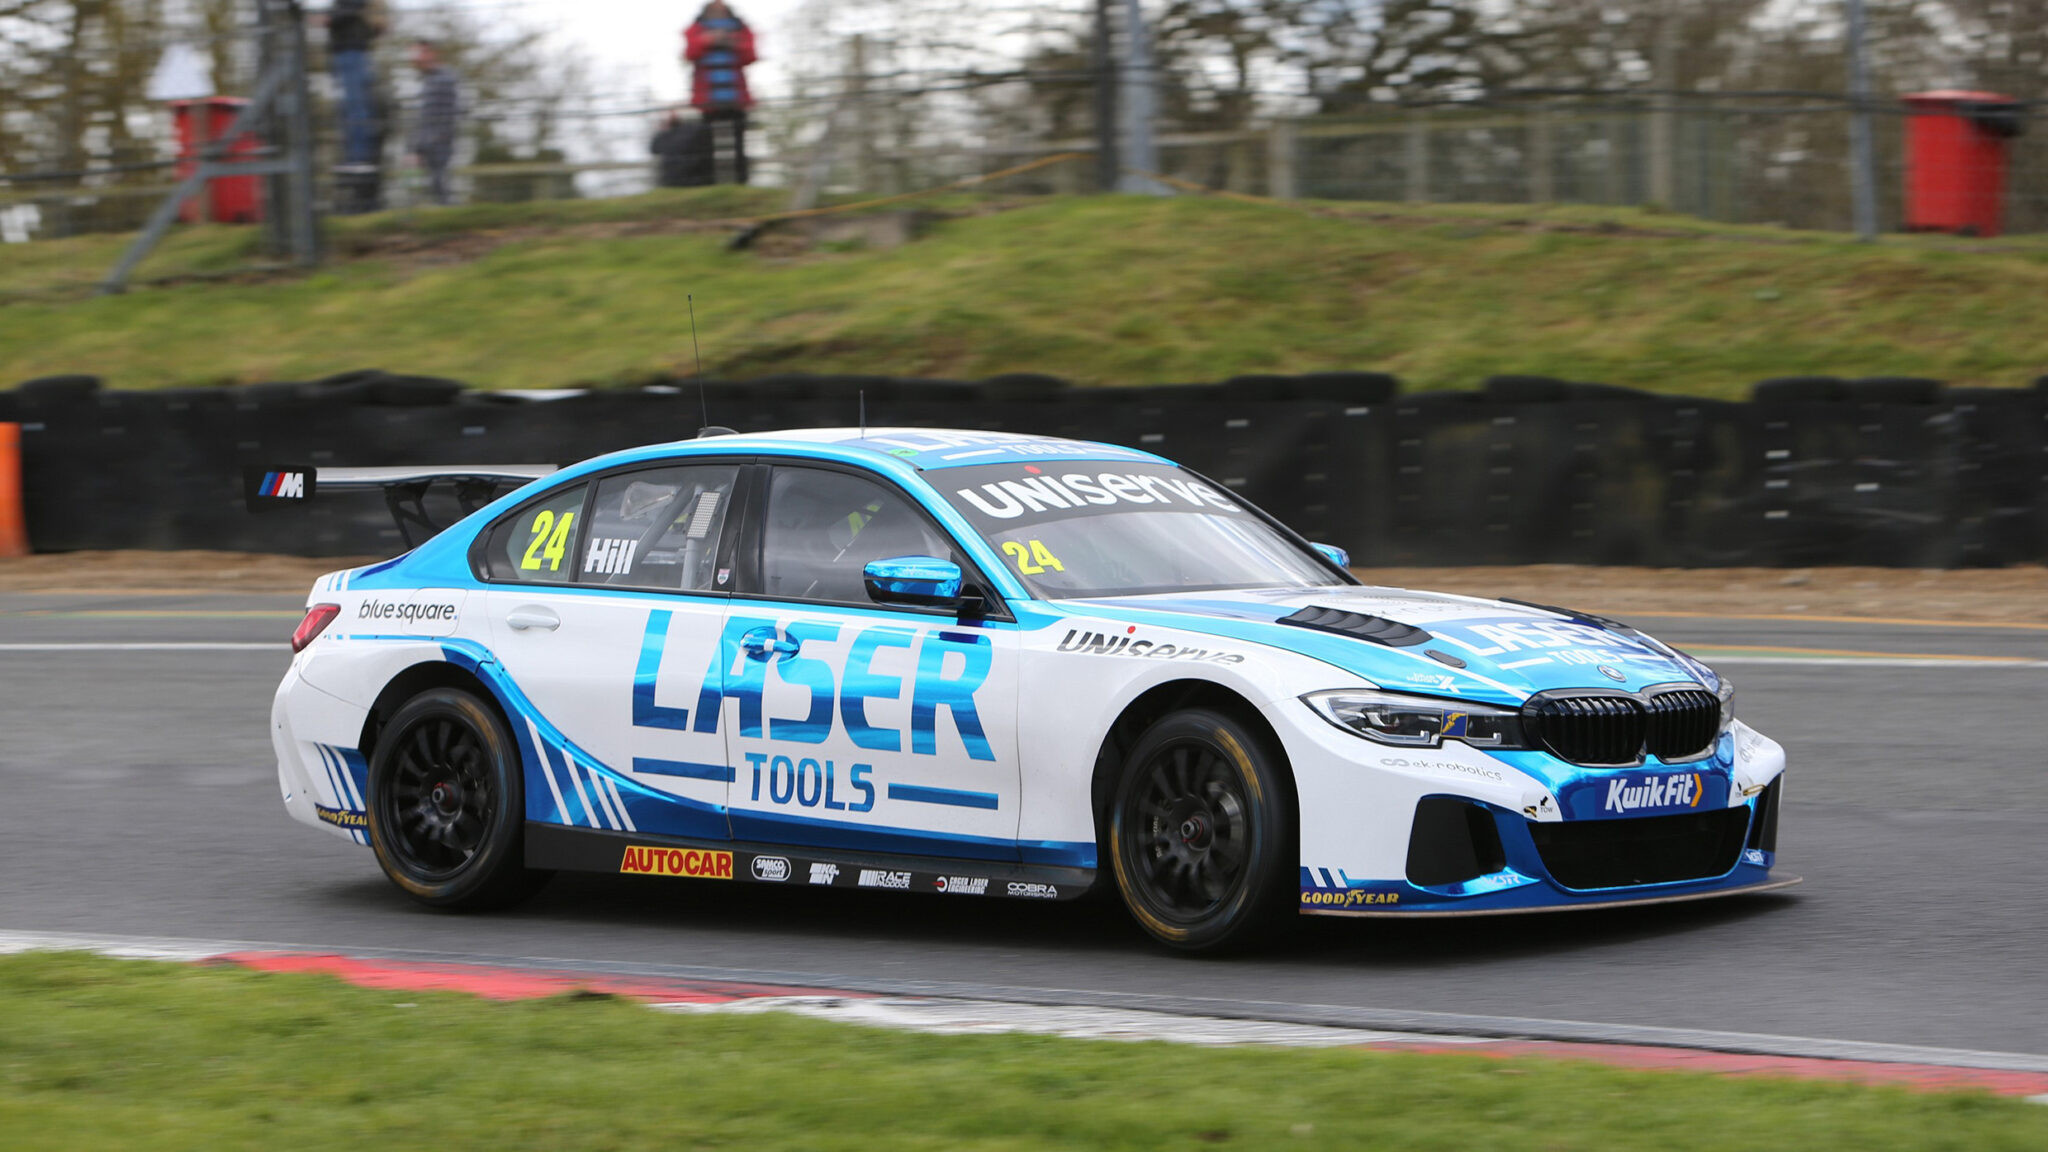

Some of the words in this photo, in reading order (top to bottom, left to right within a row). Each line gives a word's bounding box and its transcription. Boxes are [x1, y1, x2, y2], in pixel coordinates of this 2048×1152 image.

[520, 510, 575, 572] 24
[584, 538, 638, 575] Hill
[1002, 540, 1065, 575] 24
[359, 598, 394, 620] blue
[1465, 621, 1645, 657] LASER
[1547, 649, 1625, 666] TOOLS
[632, 609, 996, 762] LASER
[745, 752, 875, 813] TOOLS
[622, 847, 732, 878] AUTOCAR
[877, 871, 912, 884] RACE
[1007, 882, 1057, 894] COBRA
